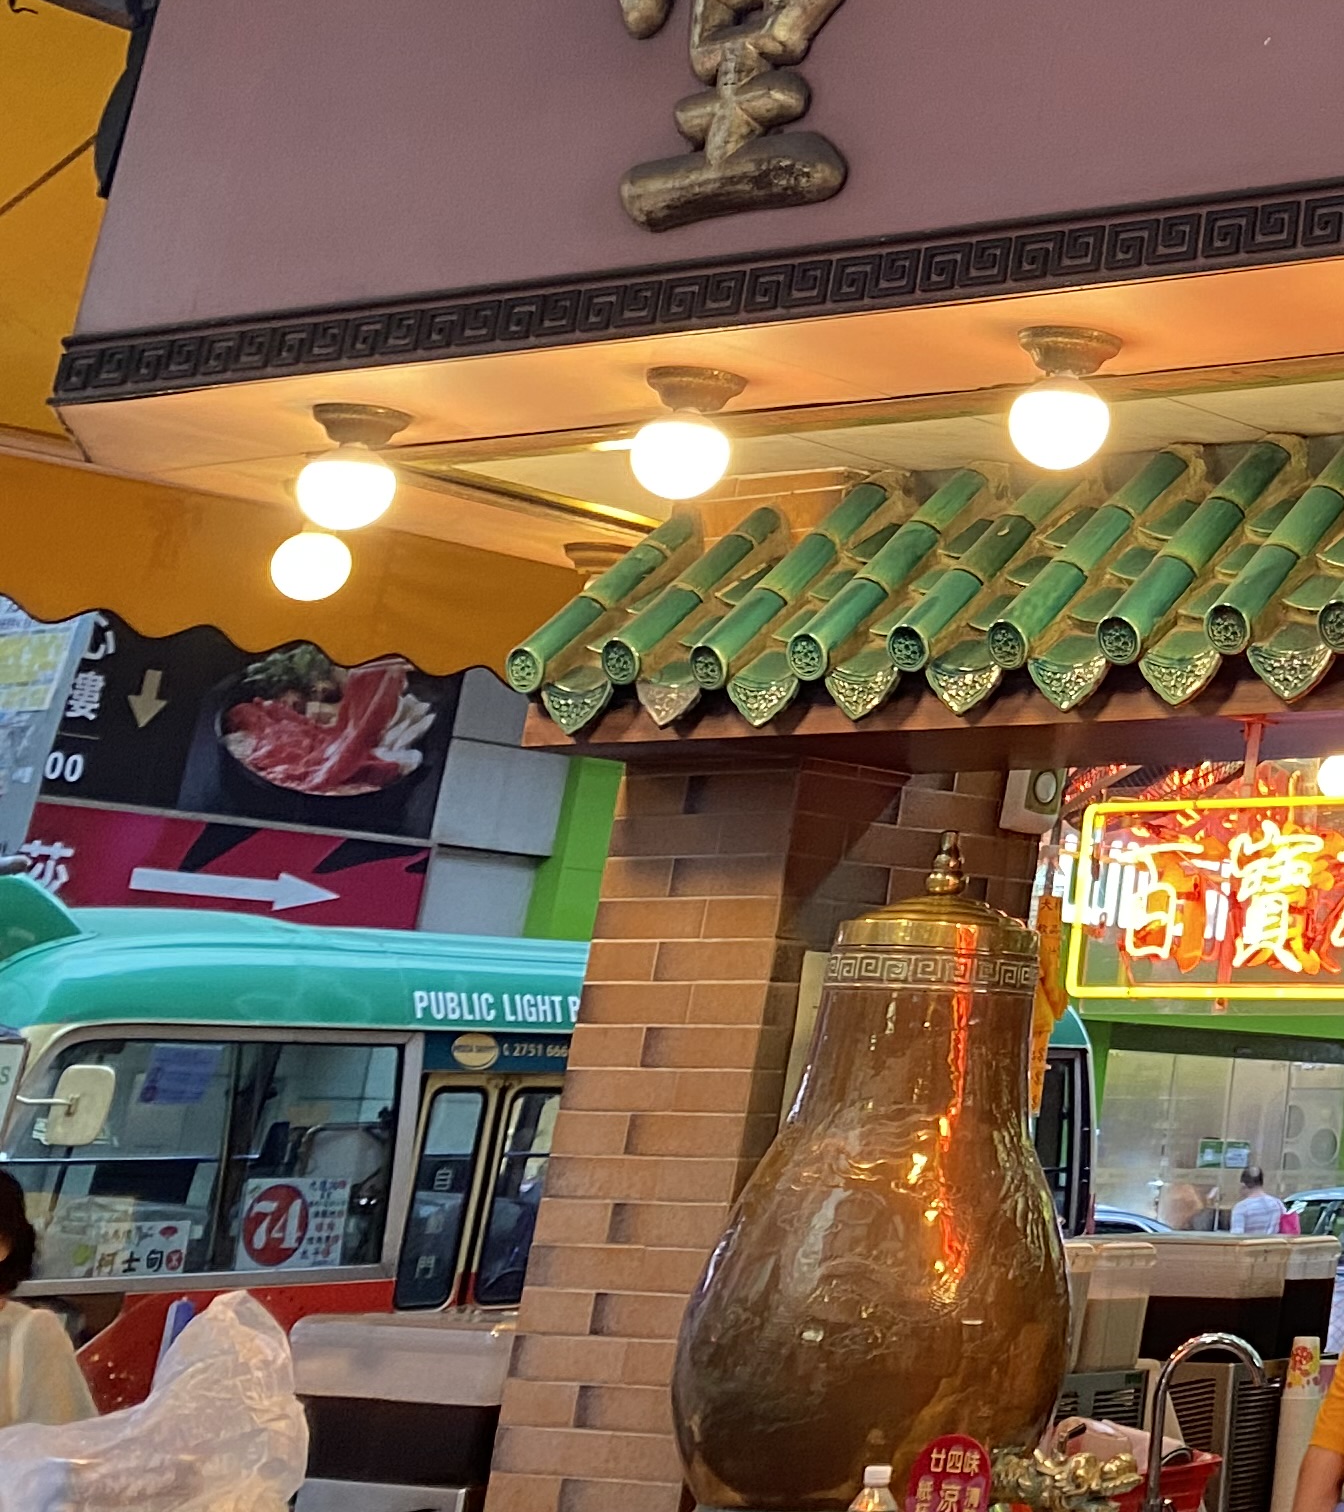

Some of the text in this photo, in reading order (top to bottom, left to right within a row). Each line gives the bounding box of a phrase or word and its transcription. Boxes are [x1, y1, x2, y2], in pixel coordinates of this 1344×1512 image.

[413, 990, 497, 1022] PUBLIC
[502, 993, 564, 1024] LIGHT
[512, 1042, 544, 1057] 2751
[250, 1198, 302, 1251] 74
[930, 1446, 981, 1477] 廿四味
